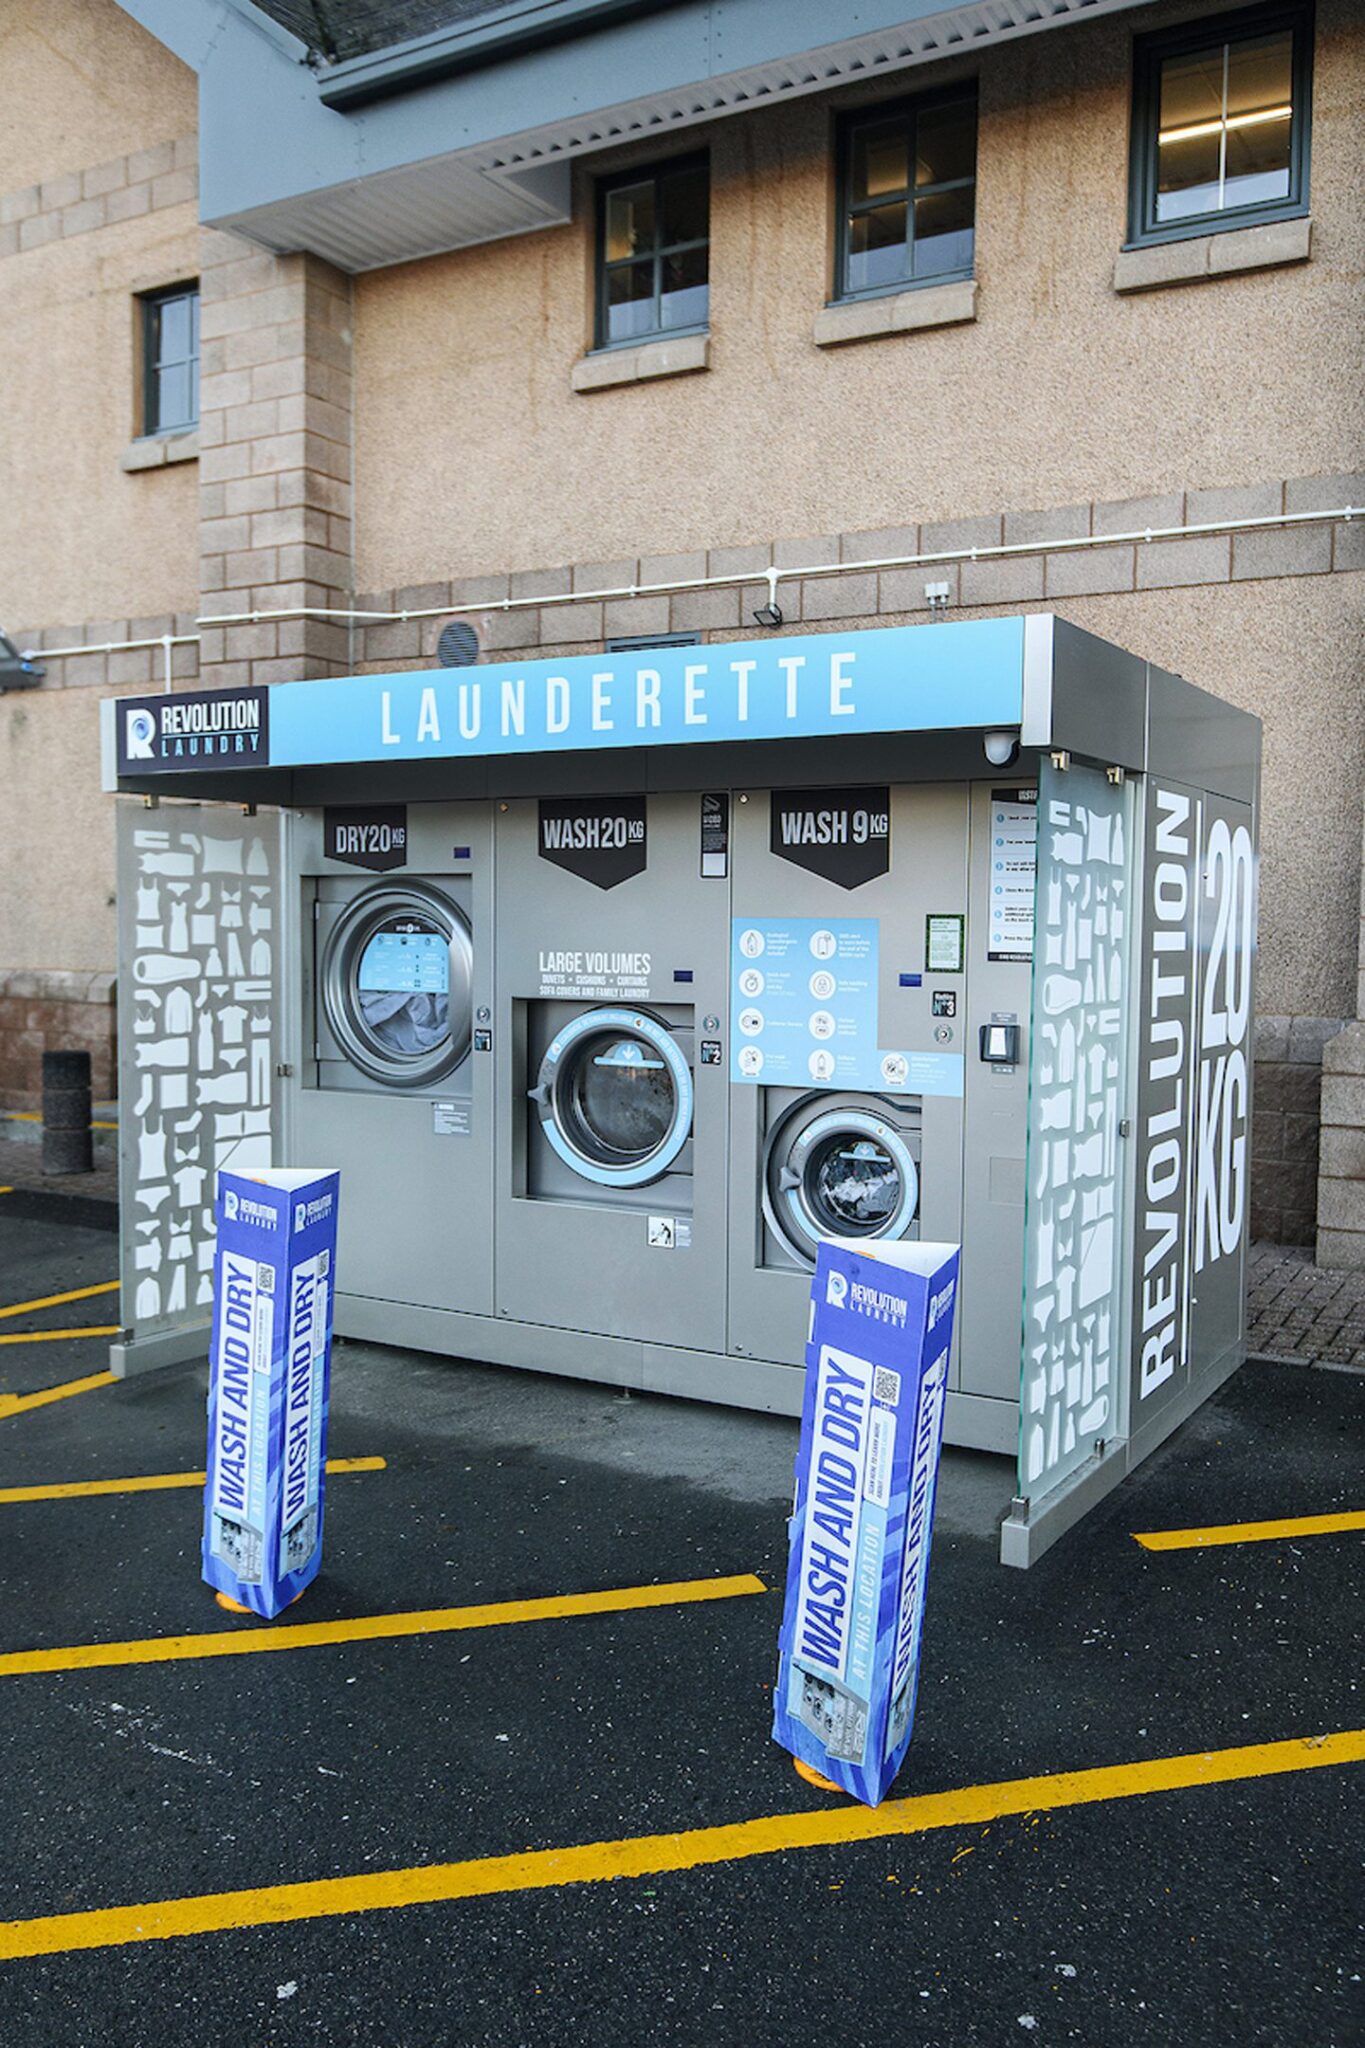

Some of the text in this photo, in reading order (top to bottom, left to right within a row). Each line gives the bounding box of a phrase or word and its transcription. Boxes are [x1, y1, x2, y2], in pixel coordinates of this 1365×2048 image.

[161, 699, 259, 734] REVOLUTION
[381, 652, 856, 745] LAUNDERETTE
[161, 734, 259, 758] LAUNDRY
[780, 810, 848, 844] WASH
[539, 951, 651, 975] LARGE VOLUMES
[581, 987, 595, 998] AND
[595, 987, 619, 998] FAMILY
[620, 988, 650, 999] LAUNDRY
[1140, 789, 1190, 1401] REVOLUTION
[239, 1197, 278, 1221] REVOLUTION
[850, 1300, 906, 1329] LAUNDRY
[851, 1282, 908, 1318] REVOLUTION
[219, 1262, 253, 1511] WASH AND DRY
[286, 1272, 315, 1520] WASH AND DRY
[254, 1388, 267, 1457] LOCATION
[801, 1357, 866, 1670] WASH AND DRY
[852, 1522, 881, 1681] AT THIS LOCATION
